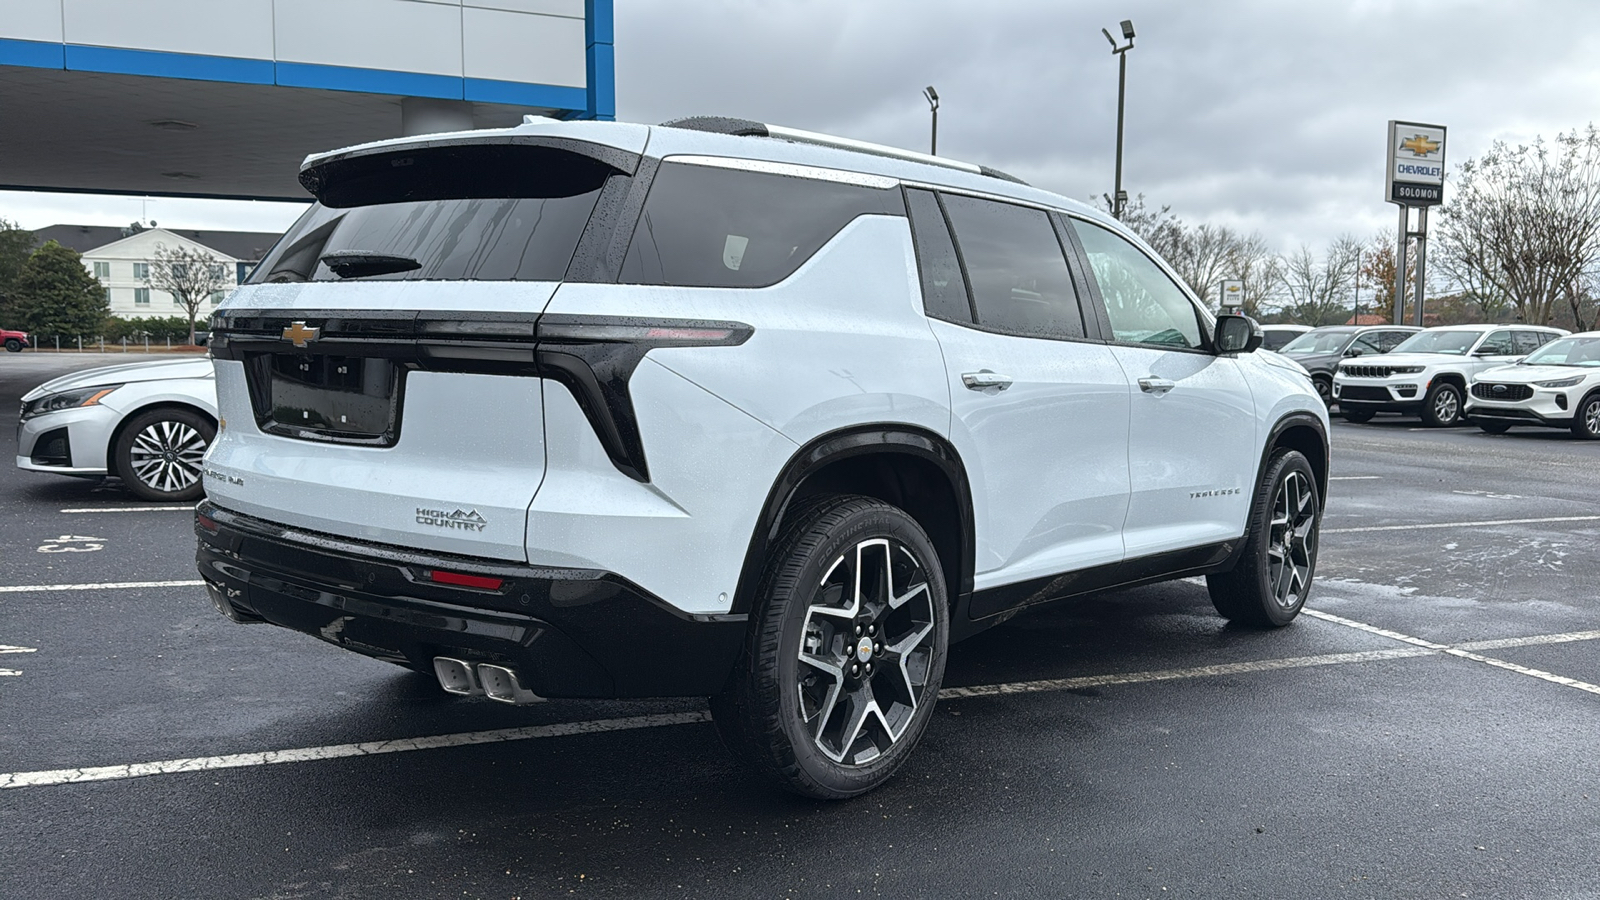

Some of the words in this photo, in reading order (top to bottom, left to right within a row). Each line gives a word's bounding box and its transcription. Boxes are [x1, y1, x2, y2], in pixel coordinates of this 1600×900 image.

[1397, 164, 1441, 177] CHEVROLET
[1399, 187, 1438, 199] SOLOMON
[1190, 488, 1241, 499] TRAVERSE
[416, 507, 450, 519] HIGH
[415, 516, 487, 532] COUNTRY
[818, 515, 891, 567] CONTINENTAL
